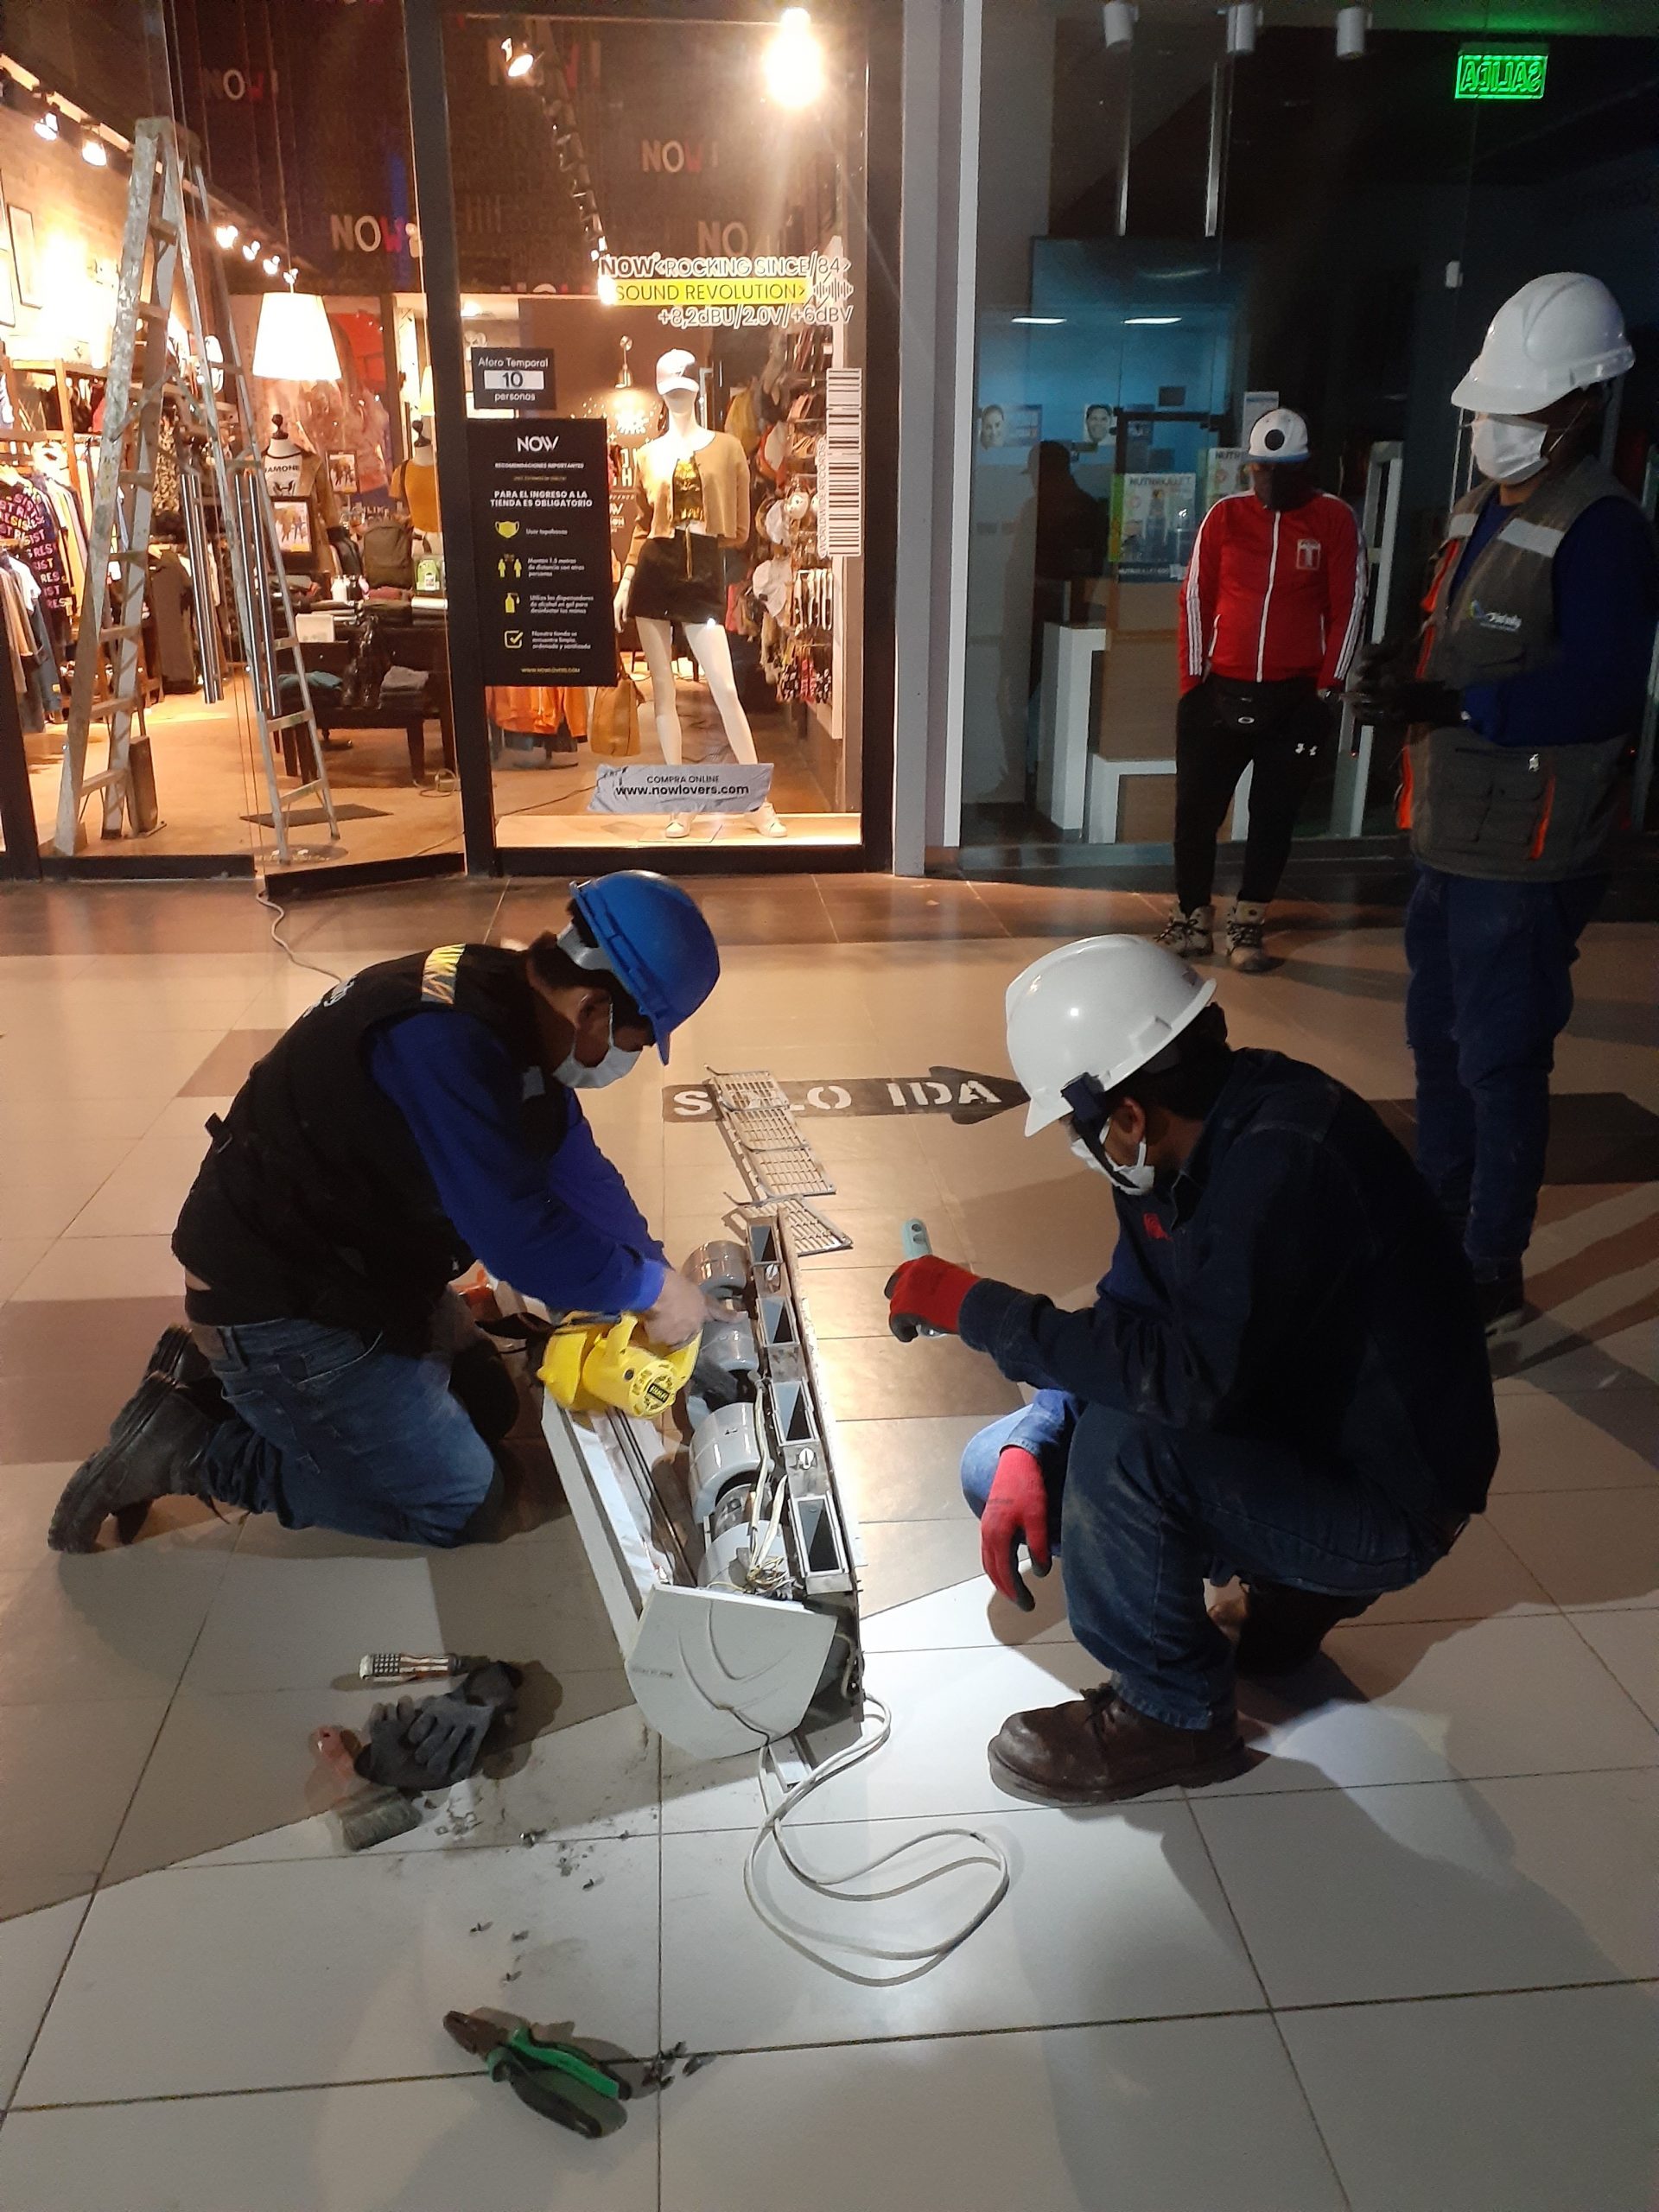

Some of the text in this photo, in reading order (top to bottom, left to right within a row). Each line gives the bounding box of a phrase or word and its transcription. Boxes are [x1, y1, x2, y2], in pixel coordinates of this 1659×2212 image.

[331, 214, 404, 253] NOW
[616, 285, 680, 302] SOUND
[478, 357, 549, 368] Aforo Temporal
[502, 372, 524, 388] 10
[494, 392, 536, 402] personas
[517, 435, 559, 452] NOW
[493, 490, 588, 499] PARA EL INGRESO A LA
[490, 499, 593, 508] TIENDA ES OBLIGATORIO
[646, 775, 720, 784] COMPRA ONLINE
[615, 785, 749, 796] www.nowlovers.com
[887, 1079, 1002, 1107] IDA
